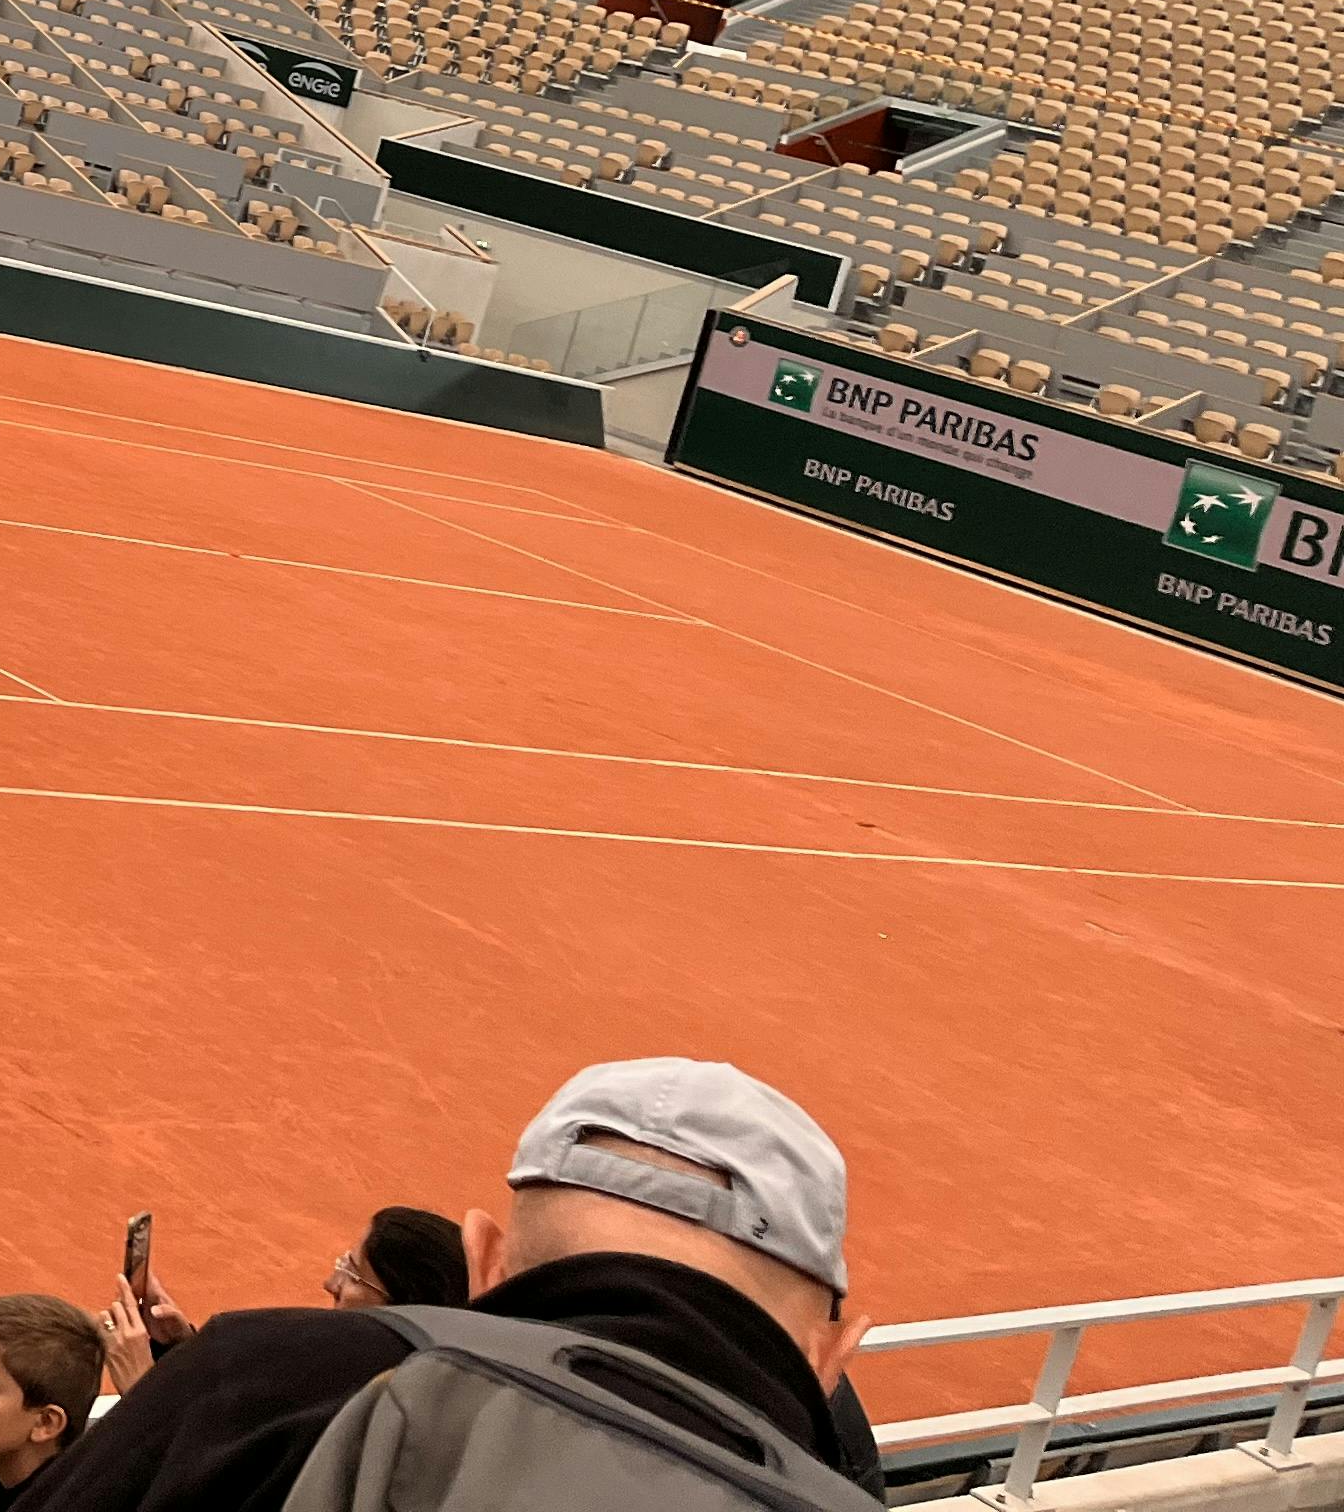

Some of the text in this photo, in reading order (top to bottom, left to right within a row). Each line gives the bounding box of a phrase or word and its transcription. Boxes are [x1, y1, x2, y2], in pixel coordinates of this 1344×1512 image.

[826, 377, 1040, 462] BNP PARIBAS
[803, 458, 956, 522] BNP PARIBAS
[1279, 510, 1344, 577] B
[1157, 572, 1336, 646] BNP PARIBAS
